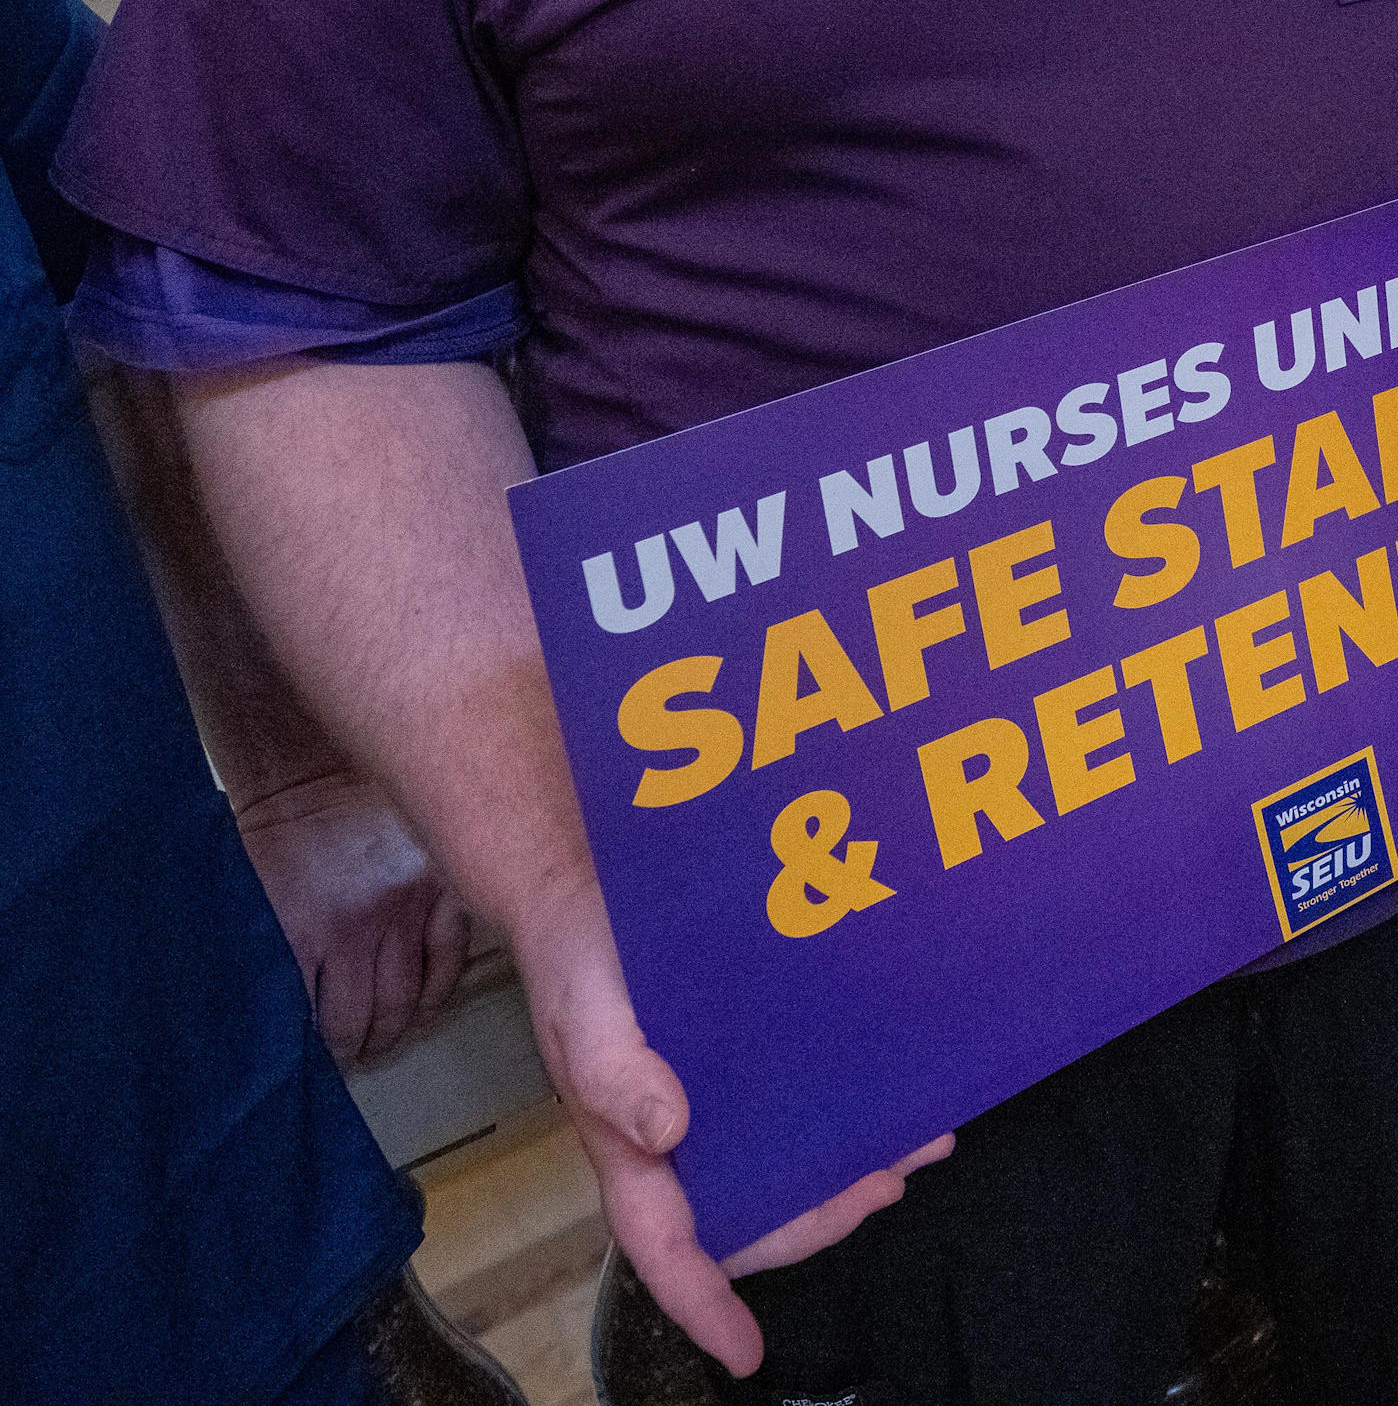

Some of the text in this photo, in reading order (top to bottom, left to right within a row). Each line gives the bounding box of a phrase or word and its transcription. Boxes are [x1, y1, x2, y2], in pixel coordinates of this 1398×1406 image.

[581, 489, 789, 636] UW
[819, 343, 1233, 557] NURSES
[615, 520, 1073, 811] SAFE
[1275, 778, 1360, 827] Wisconsin
[764, 789, 898, 941] &
[1291, 833, 1371, 900] SEIU
[1297, 863, 1379, 913] Stronger Together
